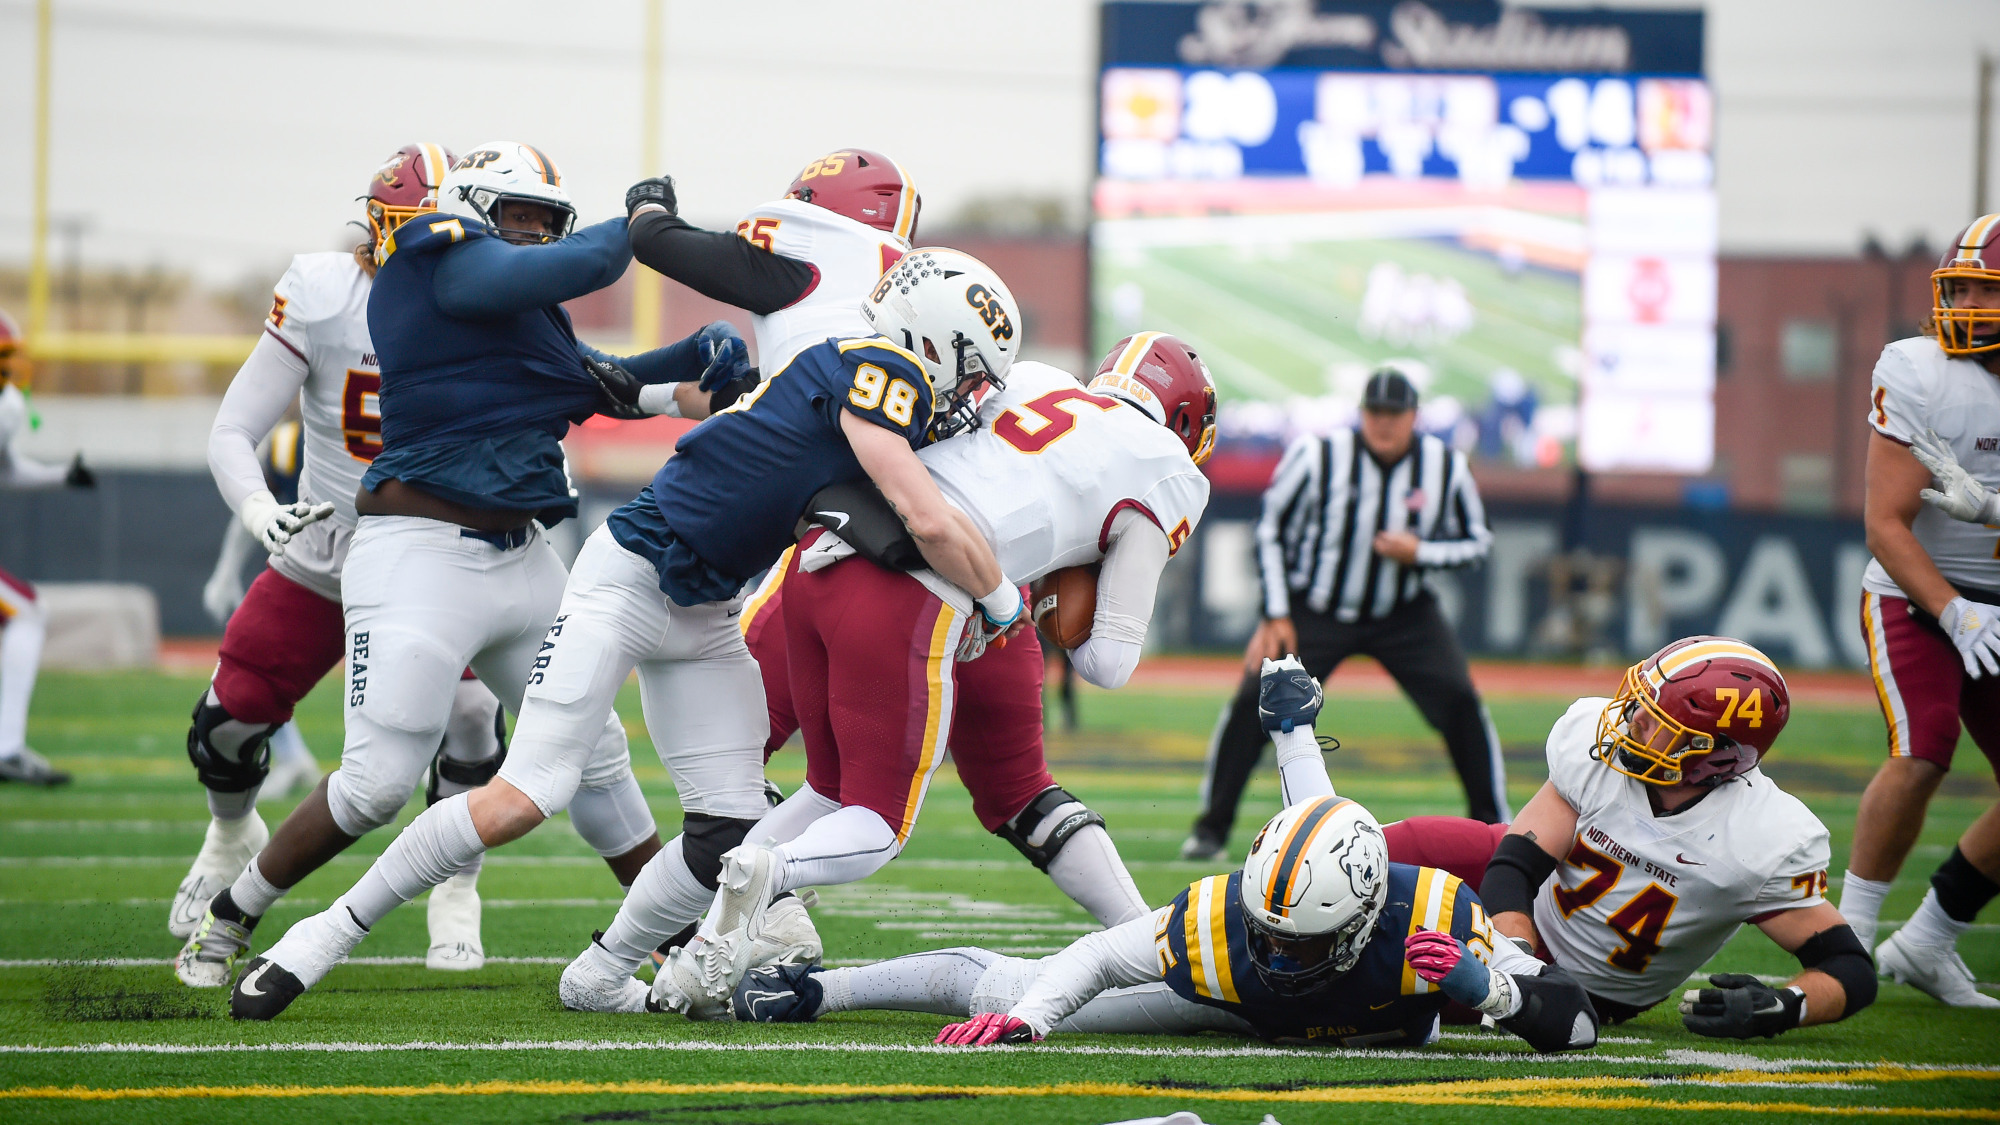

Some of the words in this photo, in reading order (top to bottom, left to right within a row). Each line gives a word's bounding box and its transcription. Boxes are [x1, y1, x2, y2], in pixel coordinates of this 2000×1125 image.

[800, 152, 852, 182] 65
[428, 218, 466, 243] 7
[965, 283, 1014, 342] CSP
[848, 362, 919, 427] 98
[991, 387, 1123, 455] 5
[1129, 382, 1152, 404] GAP
[350, 630, 370, 708] BEARS
[1715, 687, 1763, 728] 74
[1586, 825, 1641, 867] NORTHERN
[1644, 861, 1679, 889] STATE
[1552, 833, 1680, 974] 74
[1306, 1025, 1358, 1039] BEARS
